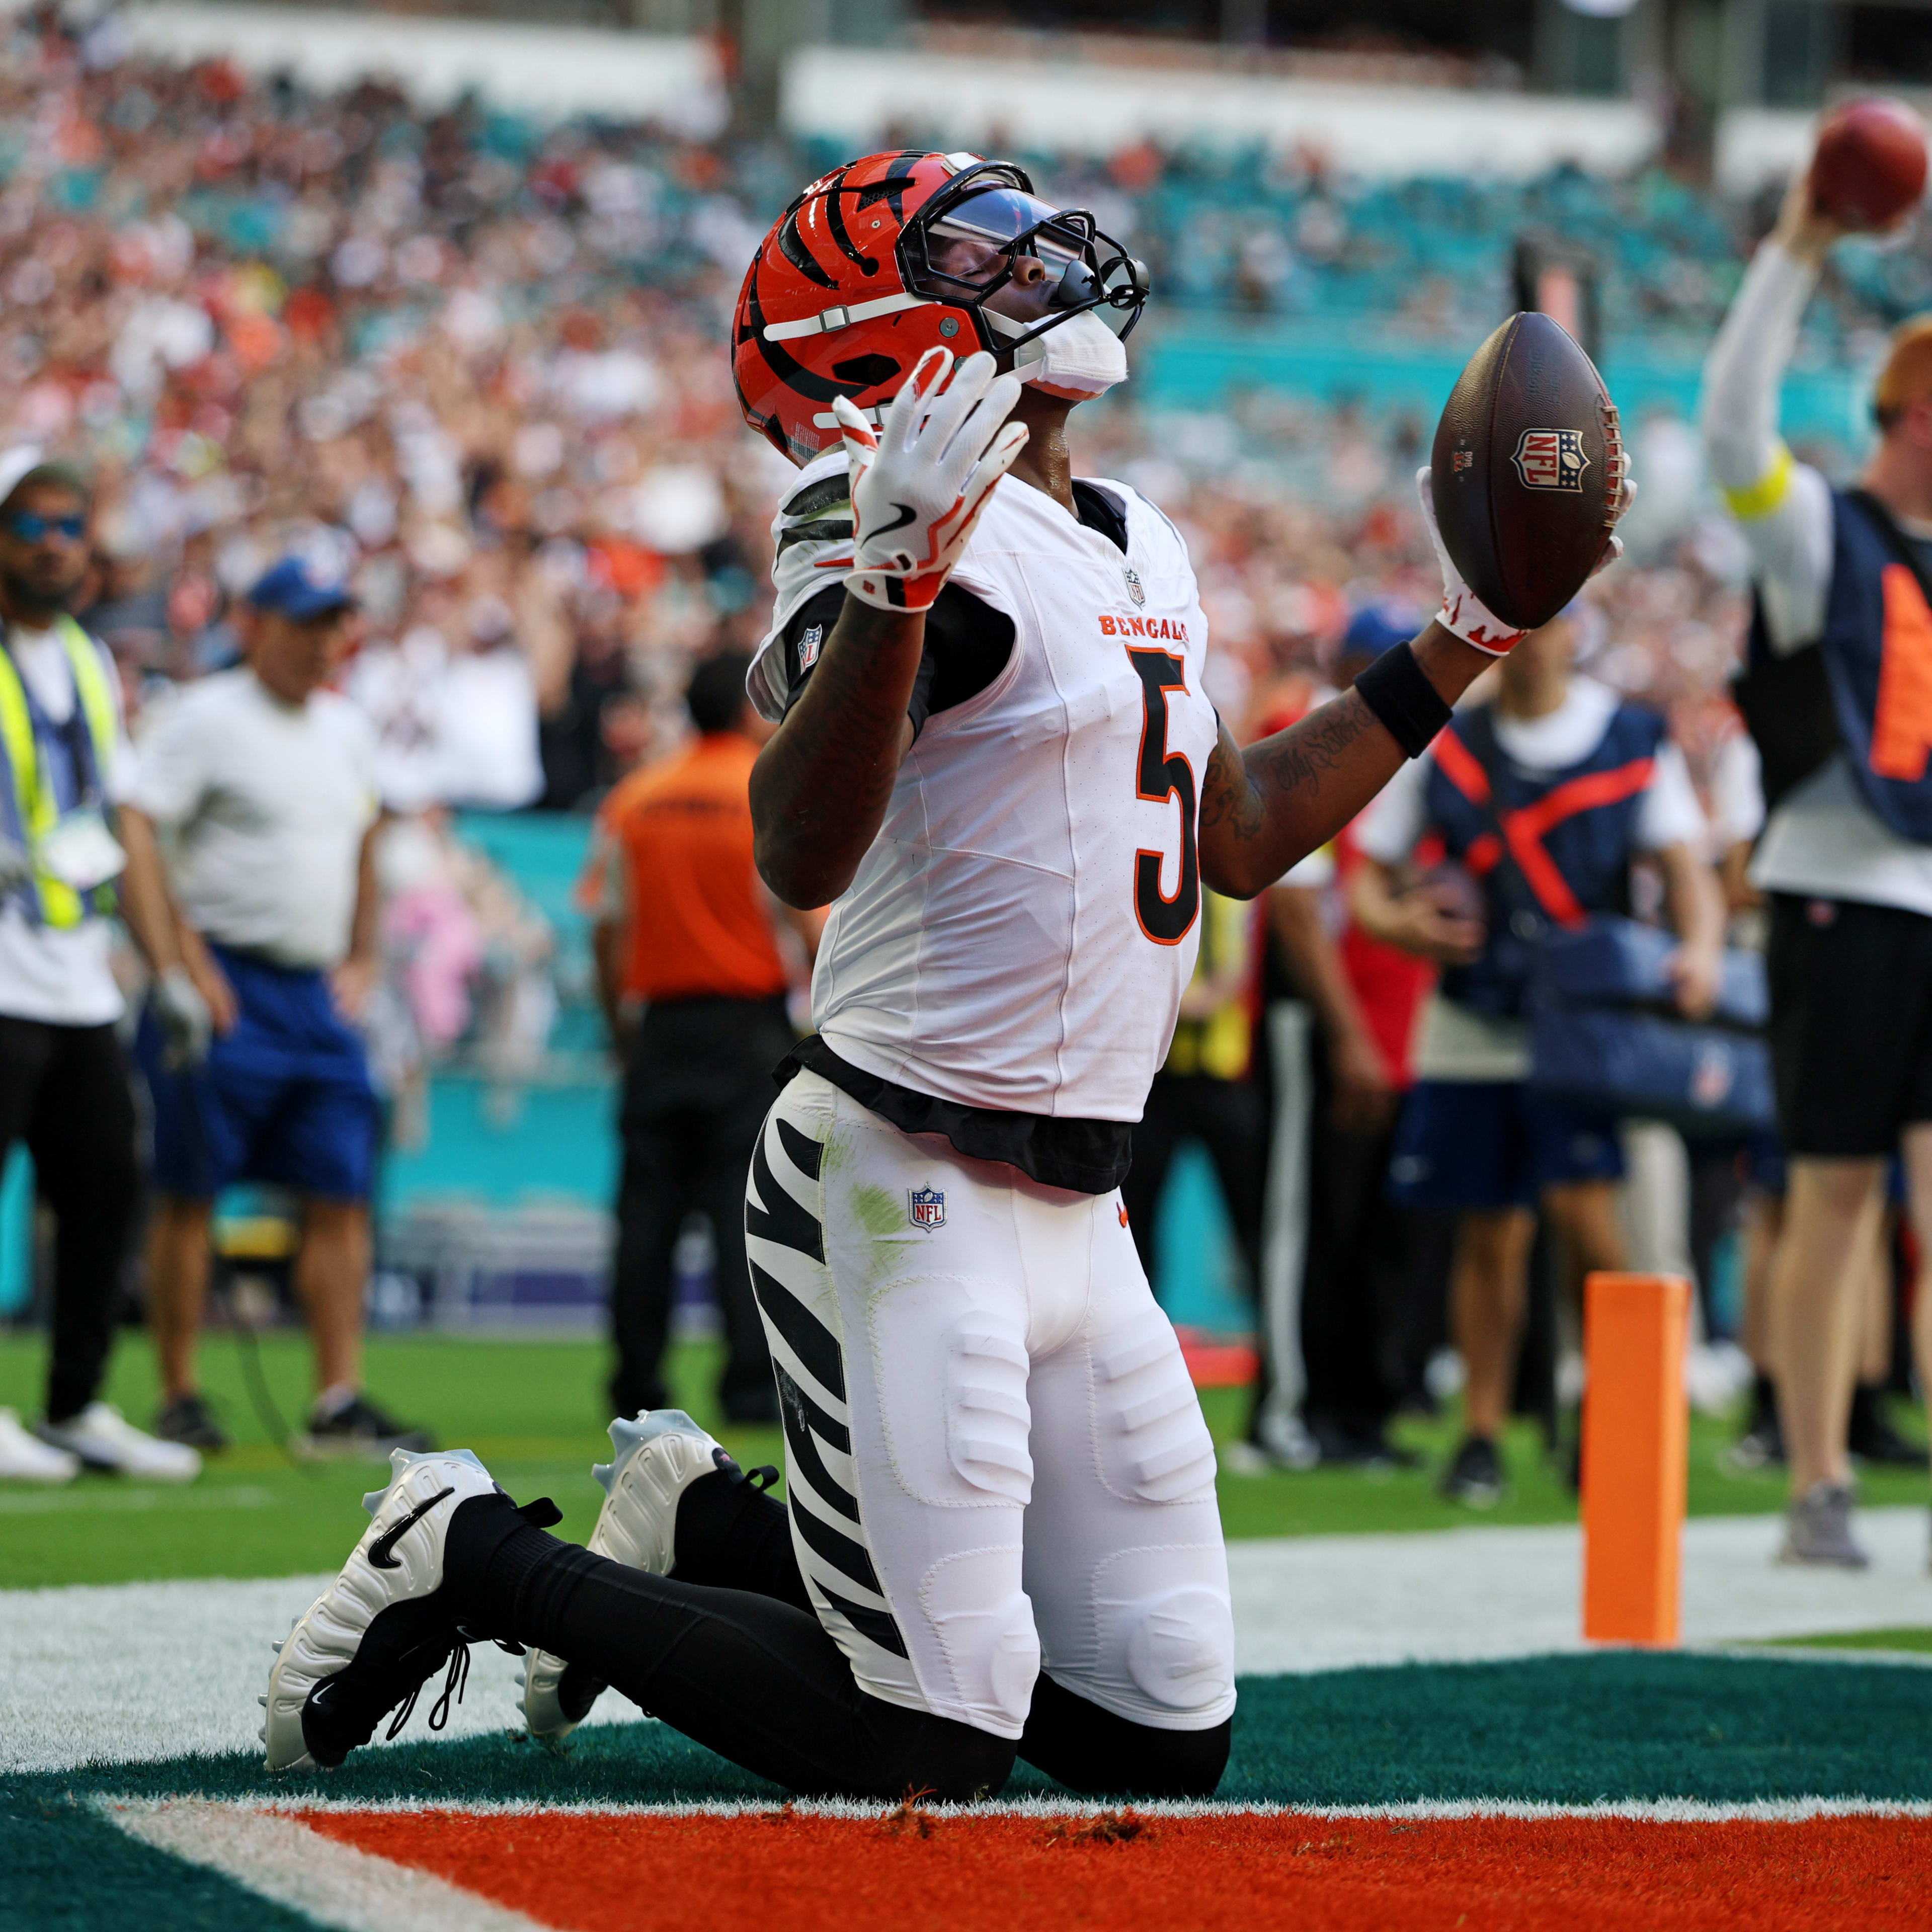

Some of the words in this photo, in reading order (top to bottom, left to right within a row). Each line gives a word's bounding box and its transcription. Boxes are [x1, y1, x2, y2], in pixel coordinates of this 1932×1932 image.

[1523, 435, 1557, 483] NFL
[1099, 615, 1189, 642] BENGALS
[1124, 643, 1200, 946] 5
[916, 1205, 941, 1223] NFL
